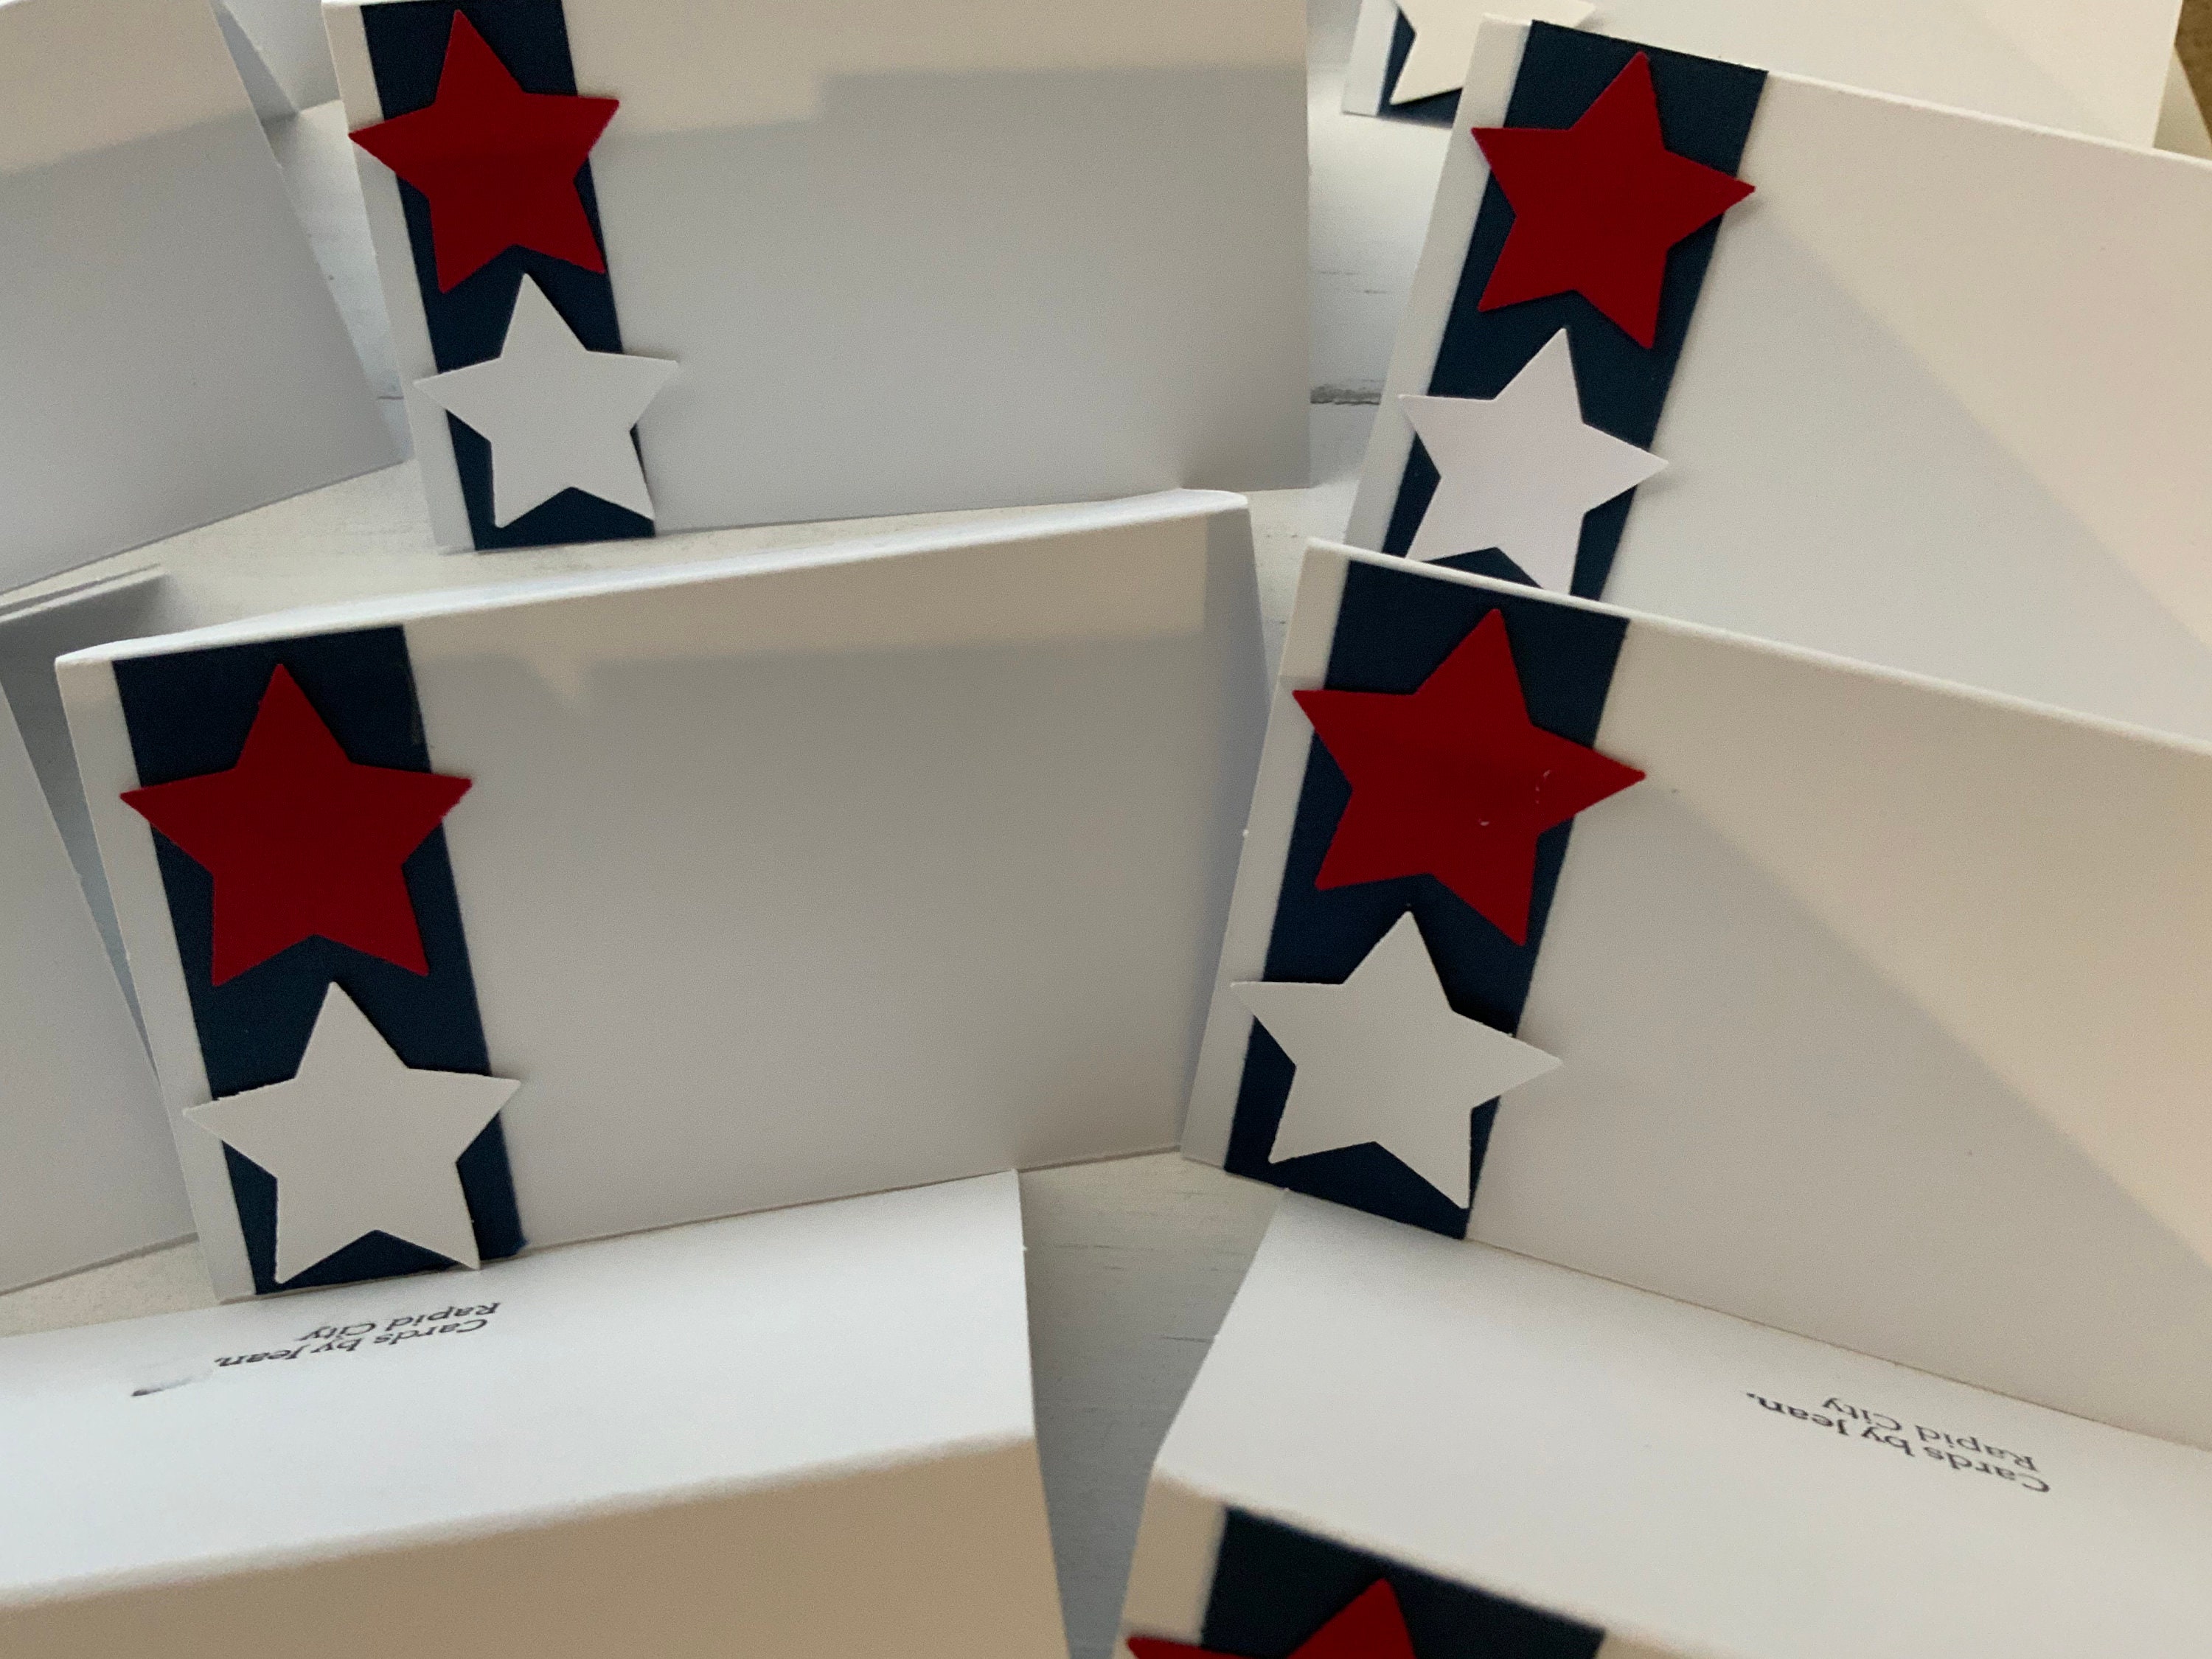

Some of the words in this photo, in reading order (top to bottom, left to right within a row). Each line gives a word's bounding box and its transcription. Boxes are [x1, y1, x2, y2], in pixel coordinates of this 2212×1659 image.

[295, 1322, 377, 1342] City
[373, 1318, 488, 1345] Cards
[385, 1301, 502, 1332] Rapid
[214, 1343, 311, 1368] Jean.
[310, 1335, 358, 1354] by
[1745, 1391, 1850, 1438] Jean.
[1821, 1397, 1903, 1432] City
[1860, 1426, 1916, 1458] by
[1915, 1425, 2039, 1472] Rapid
[1922, 1446, 2051, 1493] Cards
